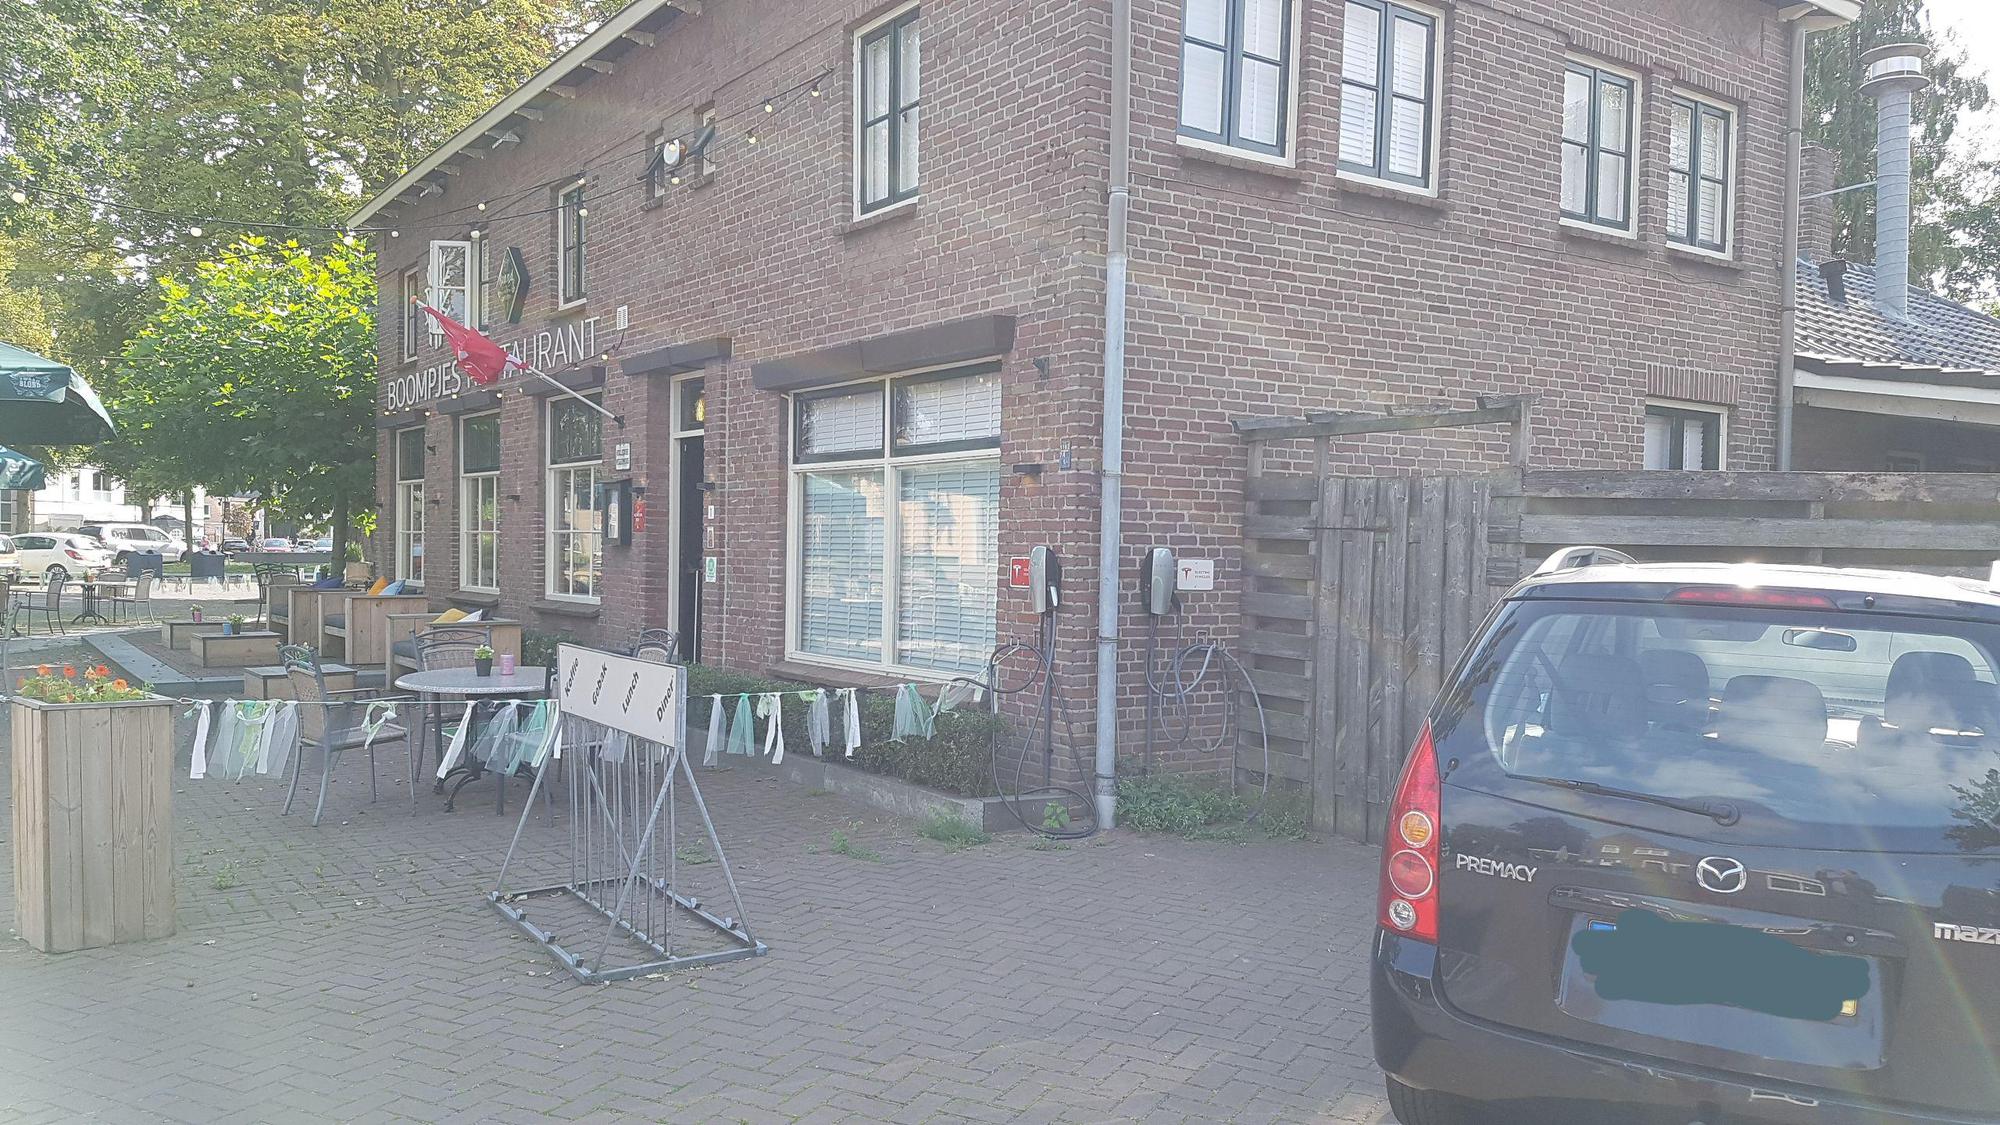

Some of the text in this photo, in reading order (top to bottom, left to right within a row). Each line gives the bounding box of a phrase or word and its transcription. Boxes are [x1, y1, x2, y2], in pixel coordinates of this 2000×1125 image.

[388, 316, 600, 410] BOOMPJES TAURANT
[564, 658, 579, 697] Koffie
[592, 662, 607, 705] Gebak
[622, 671, 639, 714] Lunch
[656, 679, 674, 722] Diner
[1456, 853, 1538, 882] PREMACY
[1934, 922, 2000, 945] maz
